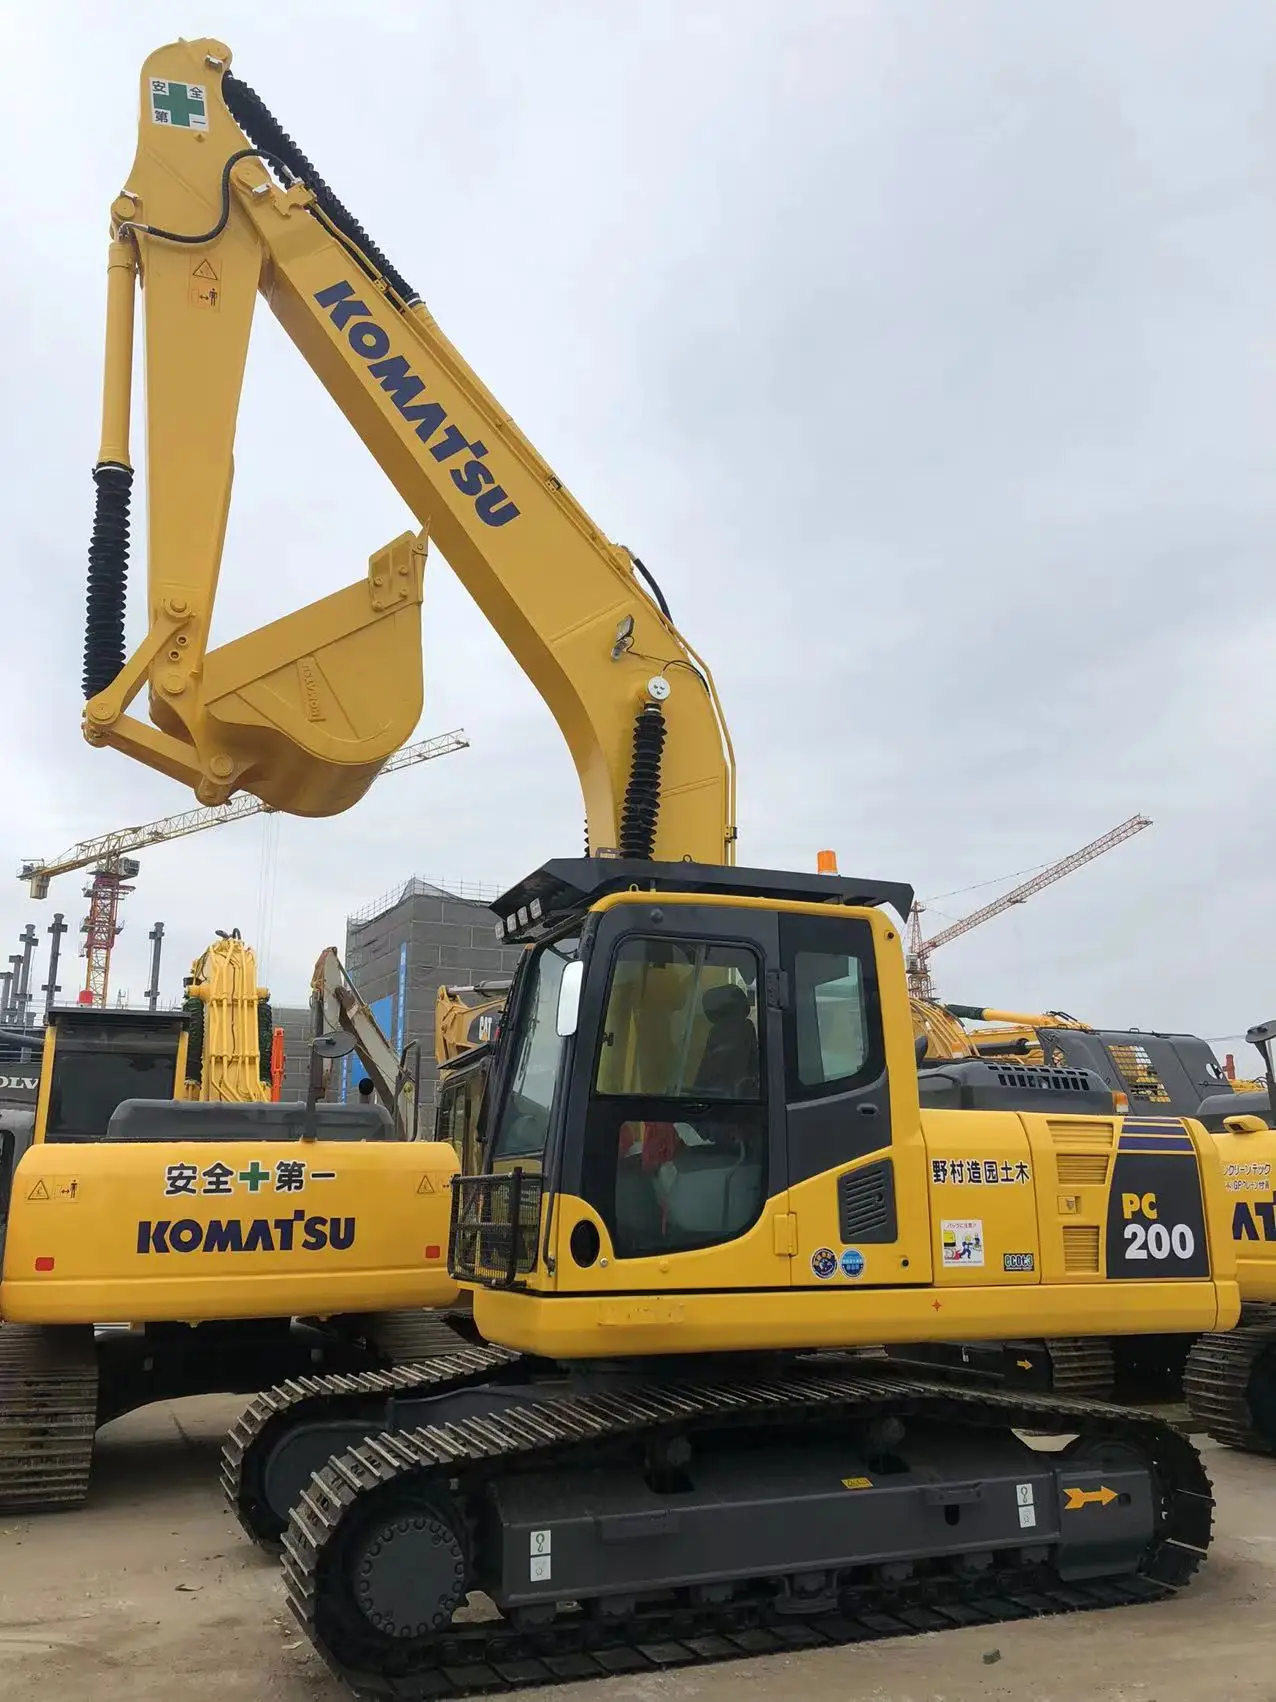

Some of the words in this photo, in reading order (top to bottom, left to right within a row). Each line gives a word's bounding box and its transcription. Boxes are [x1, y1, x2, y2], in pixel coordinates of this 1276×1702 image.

[313, 279, 521, 528] KOMATSU
[1121, 1192, 1158, 1220] PC
[136, 1209, 356, 1254] KOMATSU
[1123, 1223, 1195, 1260] 200
